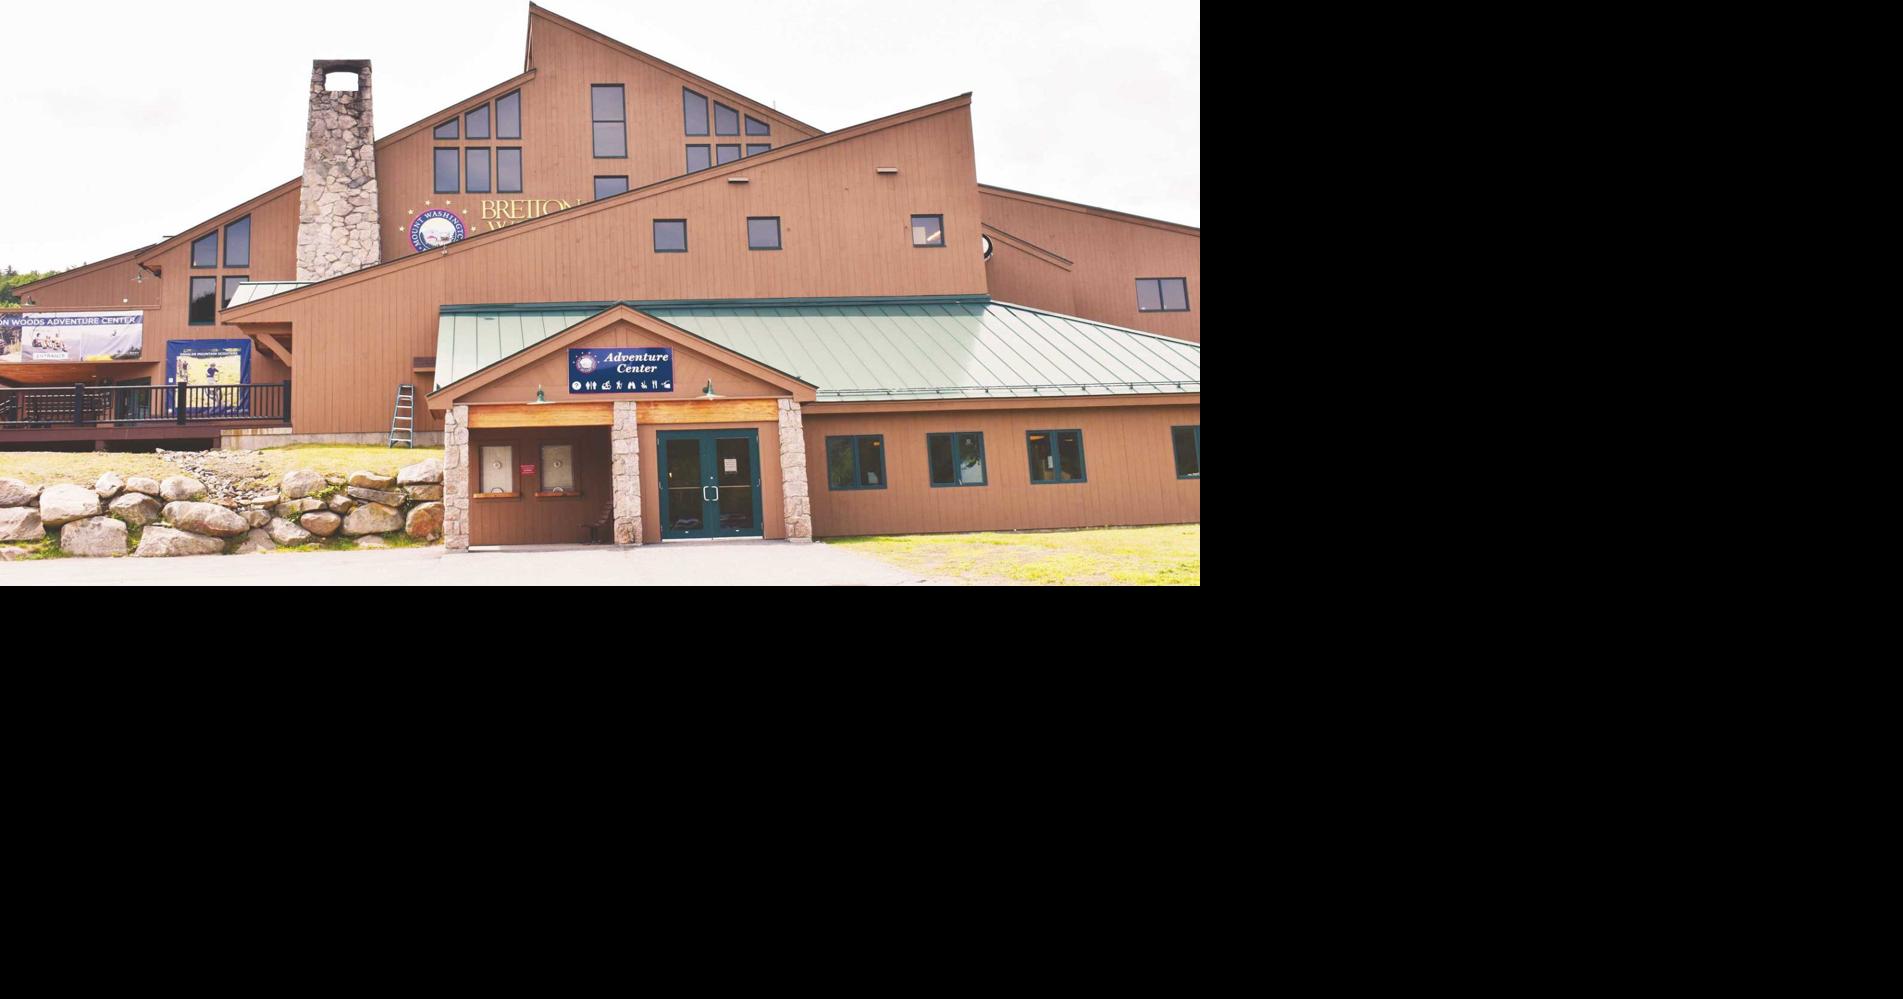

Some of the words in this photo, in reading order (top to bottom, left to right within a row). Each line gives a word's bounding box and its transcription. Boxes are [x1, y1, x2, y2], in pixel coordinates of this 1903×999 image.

[411, 216, 424, 247] MOUNT
[424, 210, 464, 240] WASHINGTO
[11, 318, 45, 326] WOODS
[47, 317, 99, 325] ADVENTURE
[101, 316, 135, 324] CENTER
[603, 352, 669, 362] Adventure
[616, 363, 657, 373] Center
